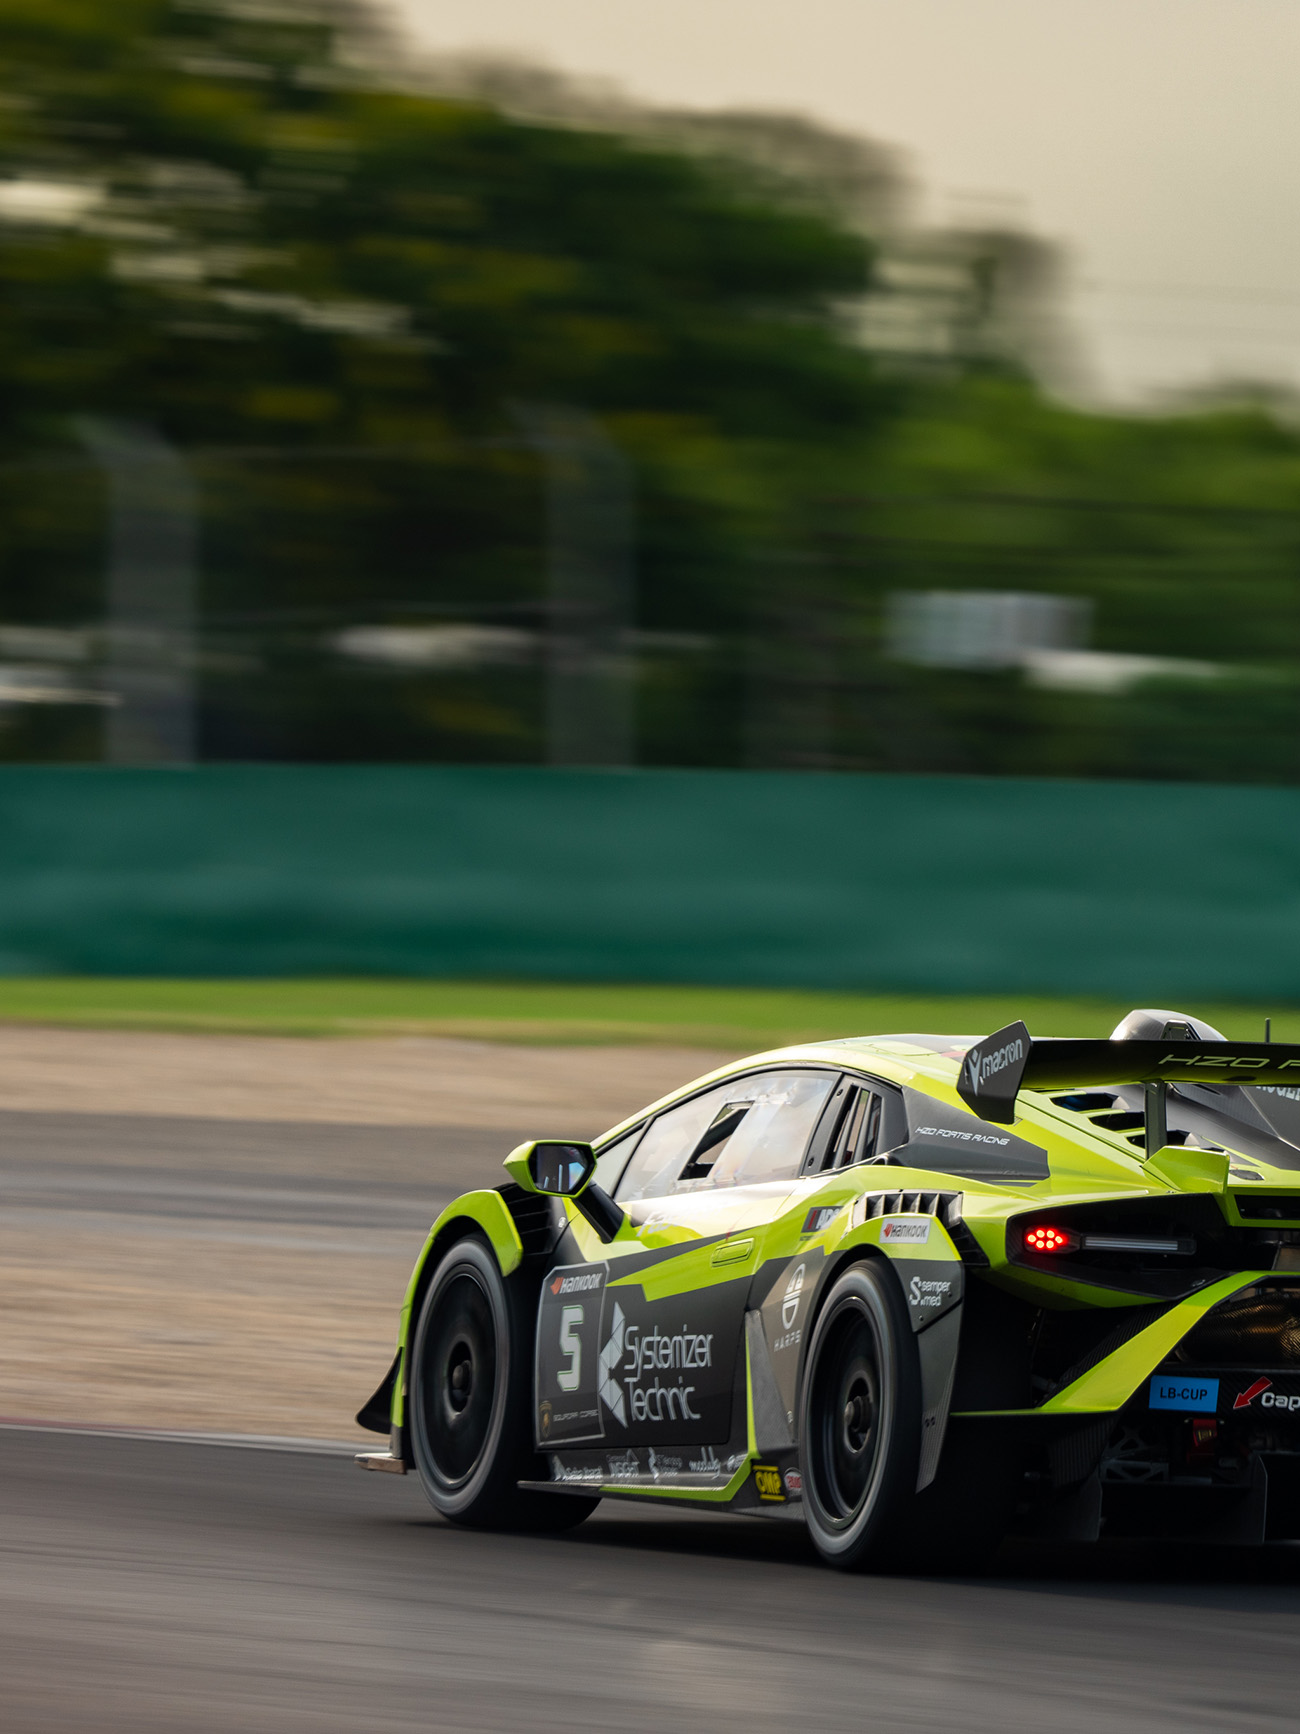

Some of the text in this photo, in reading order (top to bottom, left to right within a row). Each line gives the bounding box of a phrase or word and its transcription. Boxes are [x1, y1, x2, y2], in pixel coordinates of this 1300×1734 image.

[981, 1039, 1023, 1079] macron
[1158, 1054, 1270, 1069] HZO
[915, 1126, 1010, 1146] HZO FORTIS RACING
[920, 1280, 952, 1295] semper
[556, 1304, 585, 1393] 5
[624, 1323, 714, 1380] Systemizer
[624, 1375, 702, 1422] Technic
[1159, 1386, 1208, 1401] LB-CUP
